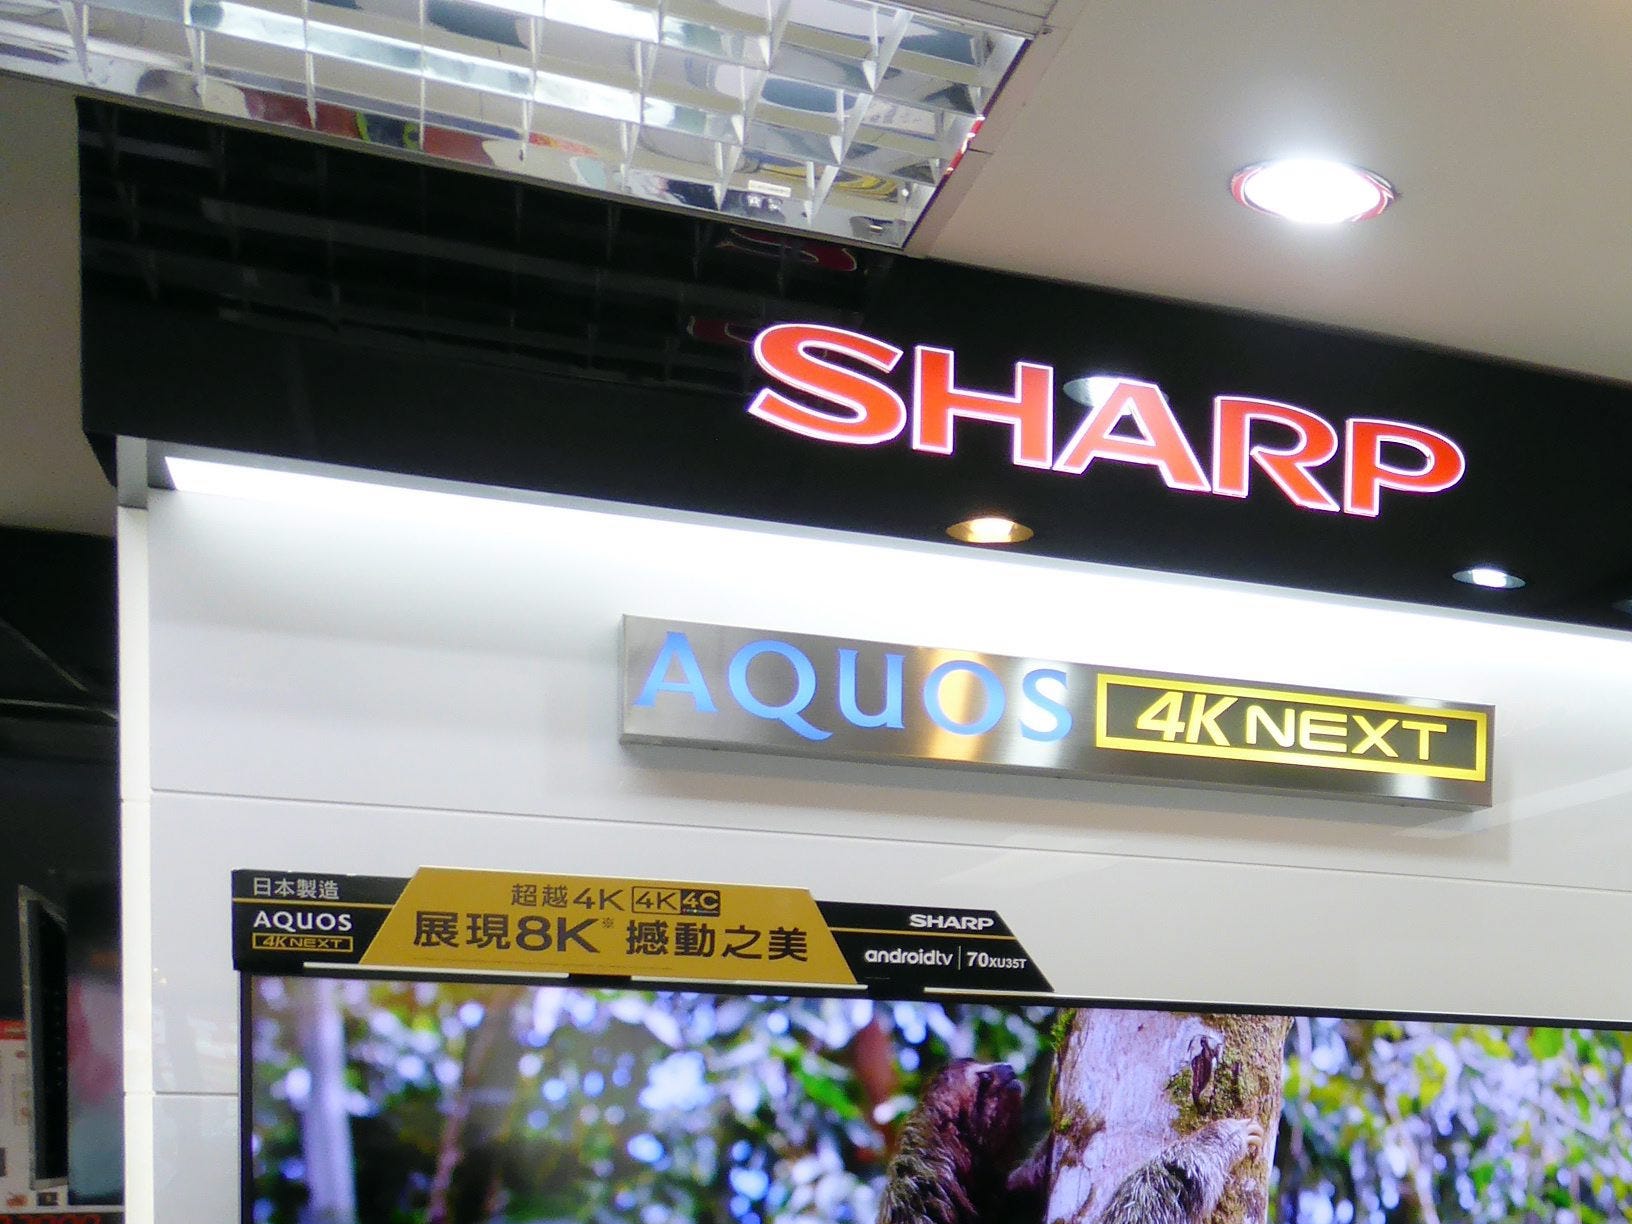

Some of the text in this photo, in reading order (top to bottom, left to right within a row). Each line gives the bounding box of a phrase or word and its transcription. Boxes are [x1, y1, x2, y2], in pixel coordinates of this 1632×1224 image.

[746, 322, 1467, 518] SHARP
[633, 630, 1448, 761] AQUOS 4K NEXT
[253, 876, 339, 900] 日本製造
[253, 911, 352, 932] AQUOS
[910, 914, 994, 931] SHARP
[263, 937, 342, 949] 4K NEXT
[626, 919, 808, 963] 撼動之美
